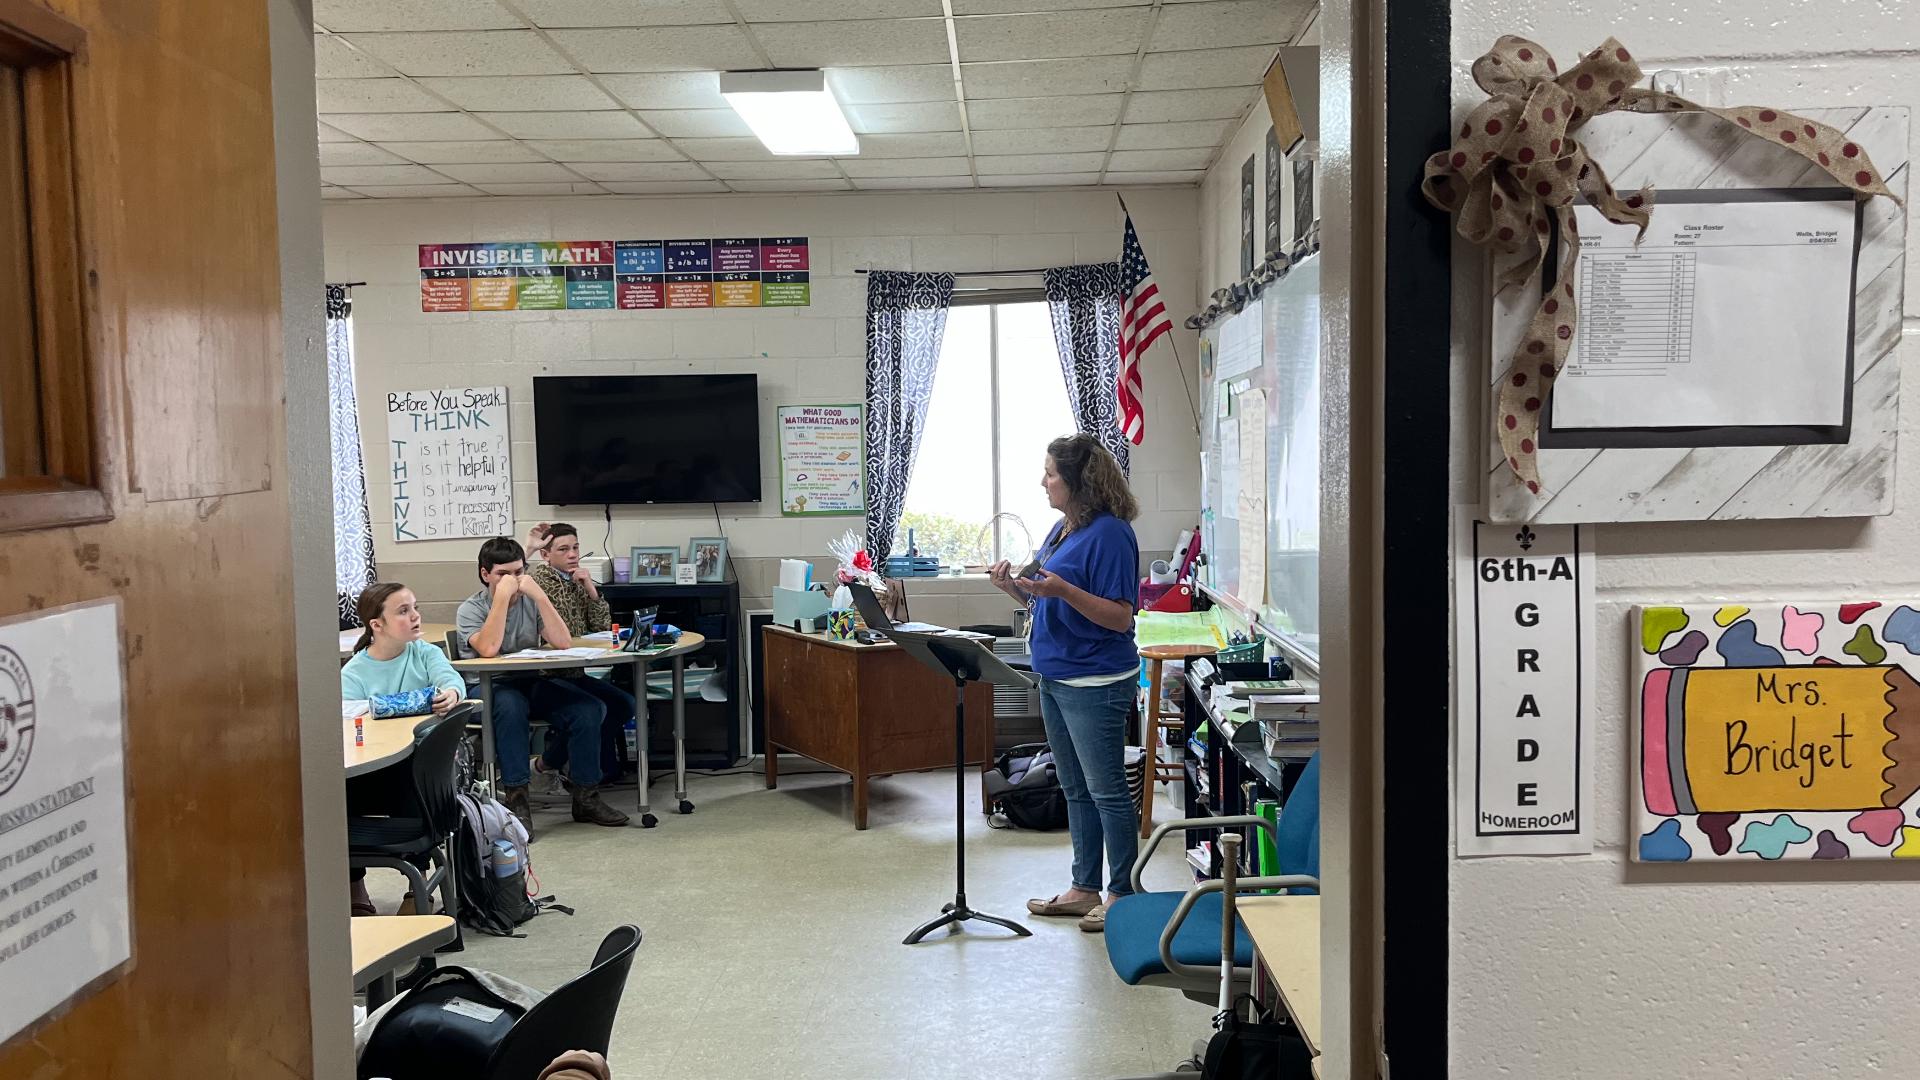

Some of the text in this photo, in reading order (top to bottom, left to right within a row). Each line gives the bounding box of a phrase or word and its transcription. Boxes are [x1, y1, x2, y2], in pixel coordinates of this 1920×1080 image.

[433, 248, 600, 265] INVISIBLE MATH
[388, 392, 428, 412] Before
[430, 390, 460, 410] You
[803, 408, 822, 416] WHAT
[408, 409, 490, 432] THINK
[785, 416, 849, 426] MATHEMATICIANS
[392, 440, 407, 458] T
[420, 441, 431, 456] is
[438, 438, 451, 456] it
[456, 438, 489, 457] true
[392, 461, 408, 480] H
[421, 464, 432, 476] is
[440, 460, 452, 476] it
[458, 455, 496, 479] helpful
[394, 480, 408, 500] I
[423, 483, 435, 498] is
[442, 480, 453, 496] it
[452, 483, 498, 496] inspiring
[394, 502, 410, 520] N
[424, 504, 437, 518] is
[443, 499, 454, 517] it
[396, 520, 418, 540] K
[424, 522, 438, 536] is
[444, 518, 455, 536] it
[1480, 557, 1573, 582] 6th-A
[1756, 672, 1828, 706] Mrs.
[1515, 603, 1541, 806] GRADE
[1724, 713, 1854, 788] Bridget
[39, 776, 94, 814] STATEMENT
[1482, 809, 1575, 828] HOMEROOM
[16, 827, 69, 864] ELEMENTARY
[69, 819, 88, 838] AND
[42, 876, 82, 909] STUDENTS
